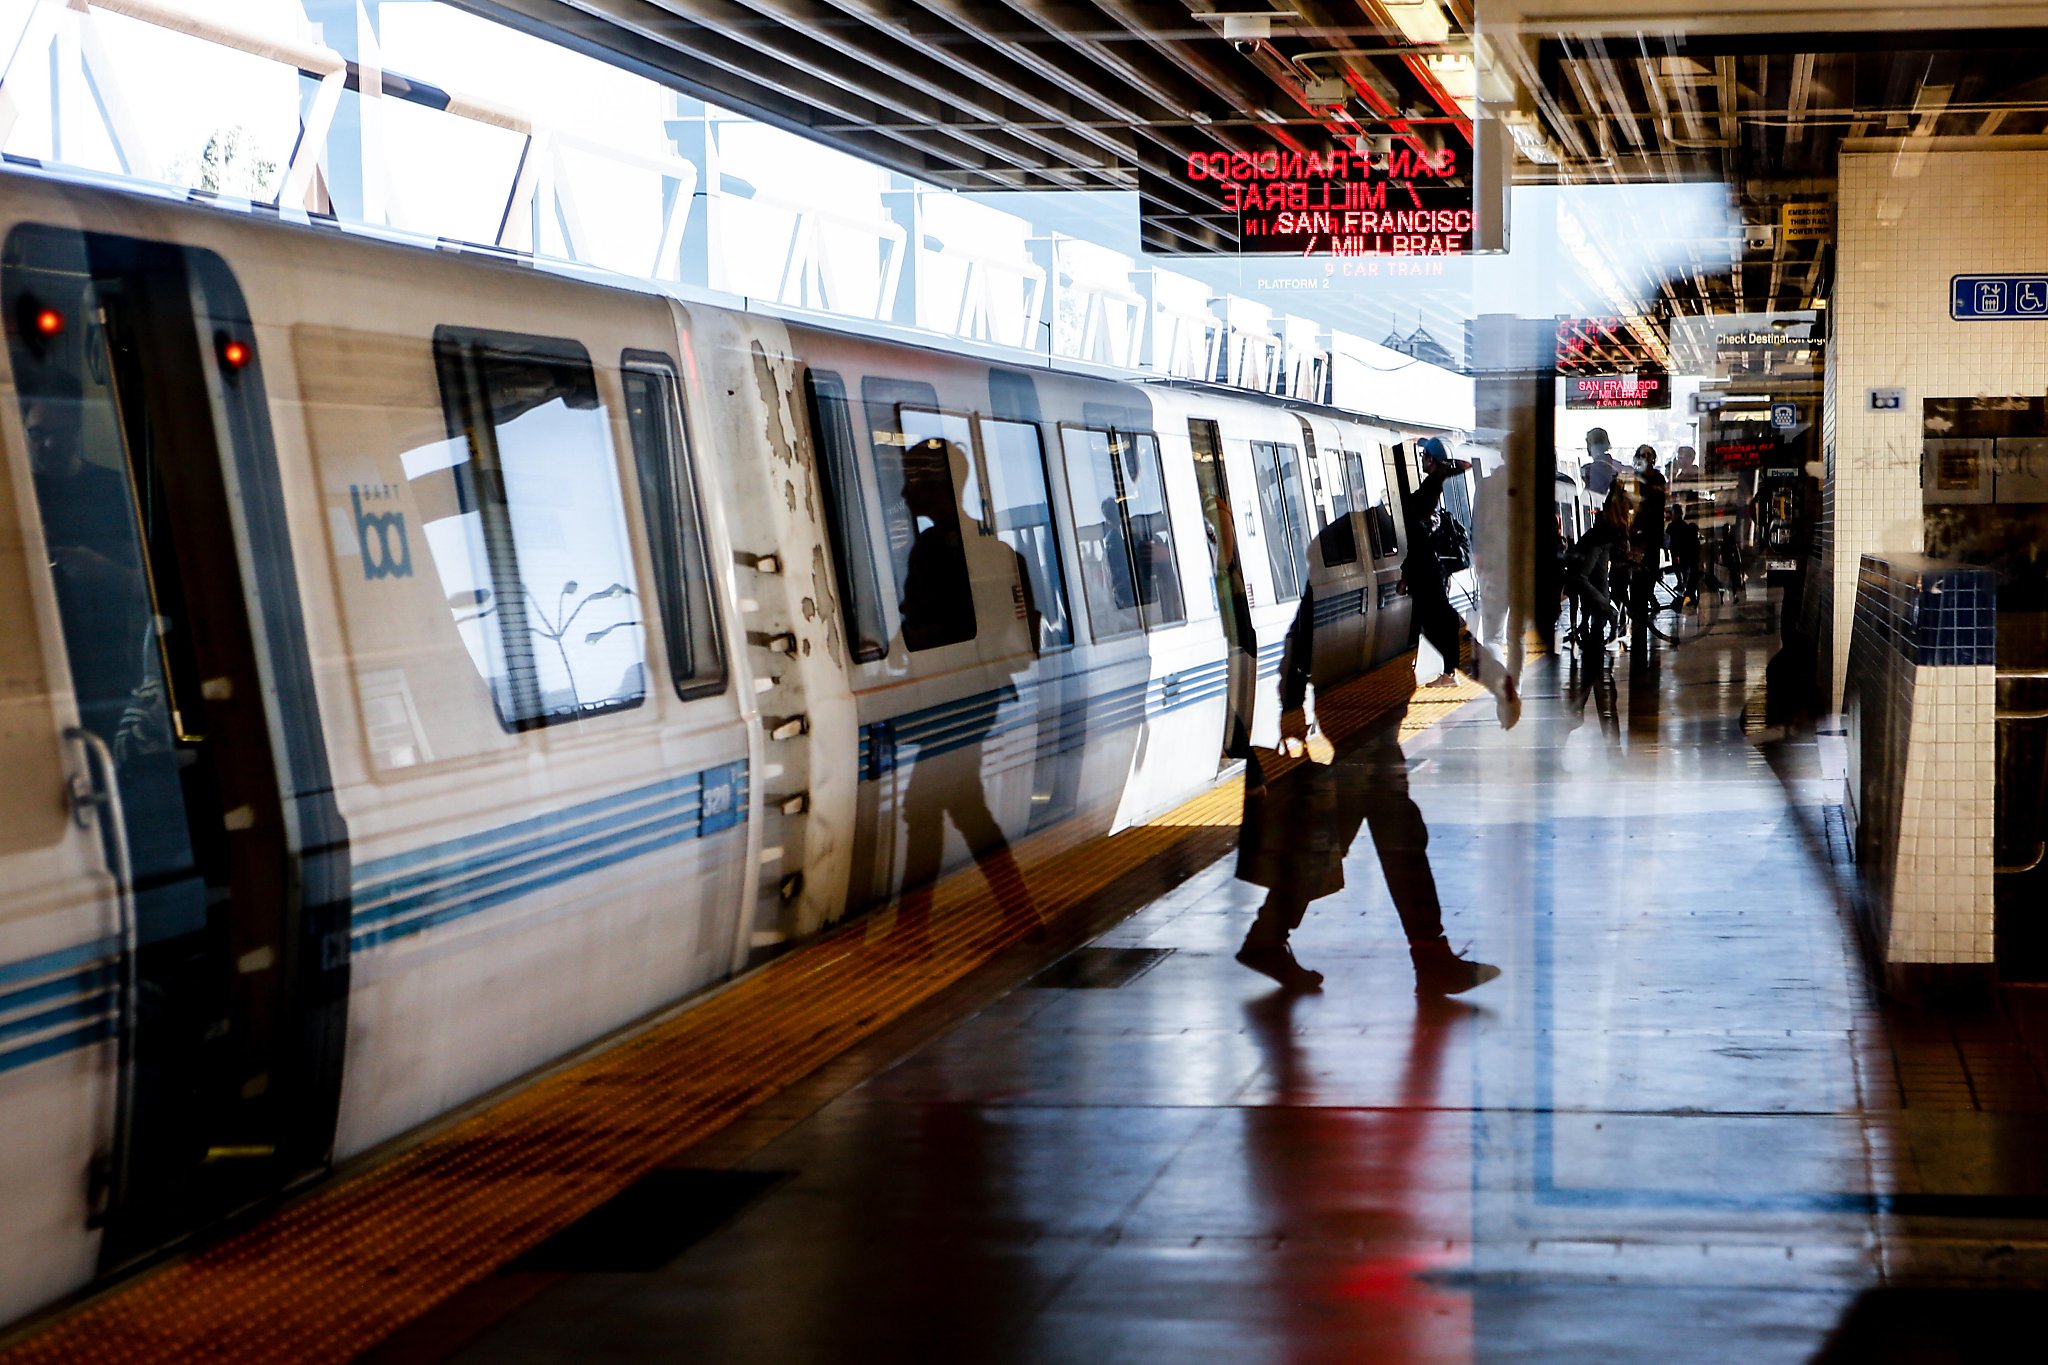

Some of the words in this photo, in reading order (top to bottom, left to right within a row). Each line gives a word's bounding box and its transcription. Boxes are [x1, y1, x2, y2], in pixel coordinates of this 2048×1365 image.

[1788, 208, 1829, 216] EMERGENCY
[1278, 211, 1330, 234] SAN
[1345, 210, 1478, 234] FRANCISC
[1791, 218, 1810, 226] THIRD
[1812, 218, 1828, 226] RAIL
[1331, 235, 1463, 257] MILLBRAE
[1343, 262, 1379, 277] CAR
[1387, 261, 1444, 276] TRAIN
[1257, 279, 1318, 289] PLATFORM
[1322, 278, 1330, 289] 2
[1715, 332, 1747, 345] Check
[1578, 380, 1599, 391] SAN
[1603, 380, 1659, 391] FRANCISCO
[1598, 389, 1649, 399] MILLBRAE
